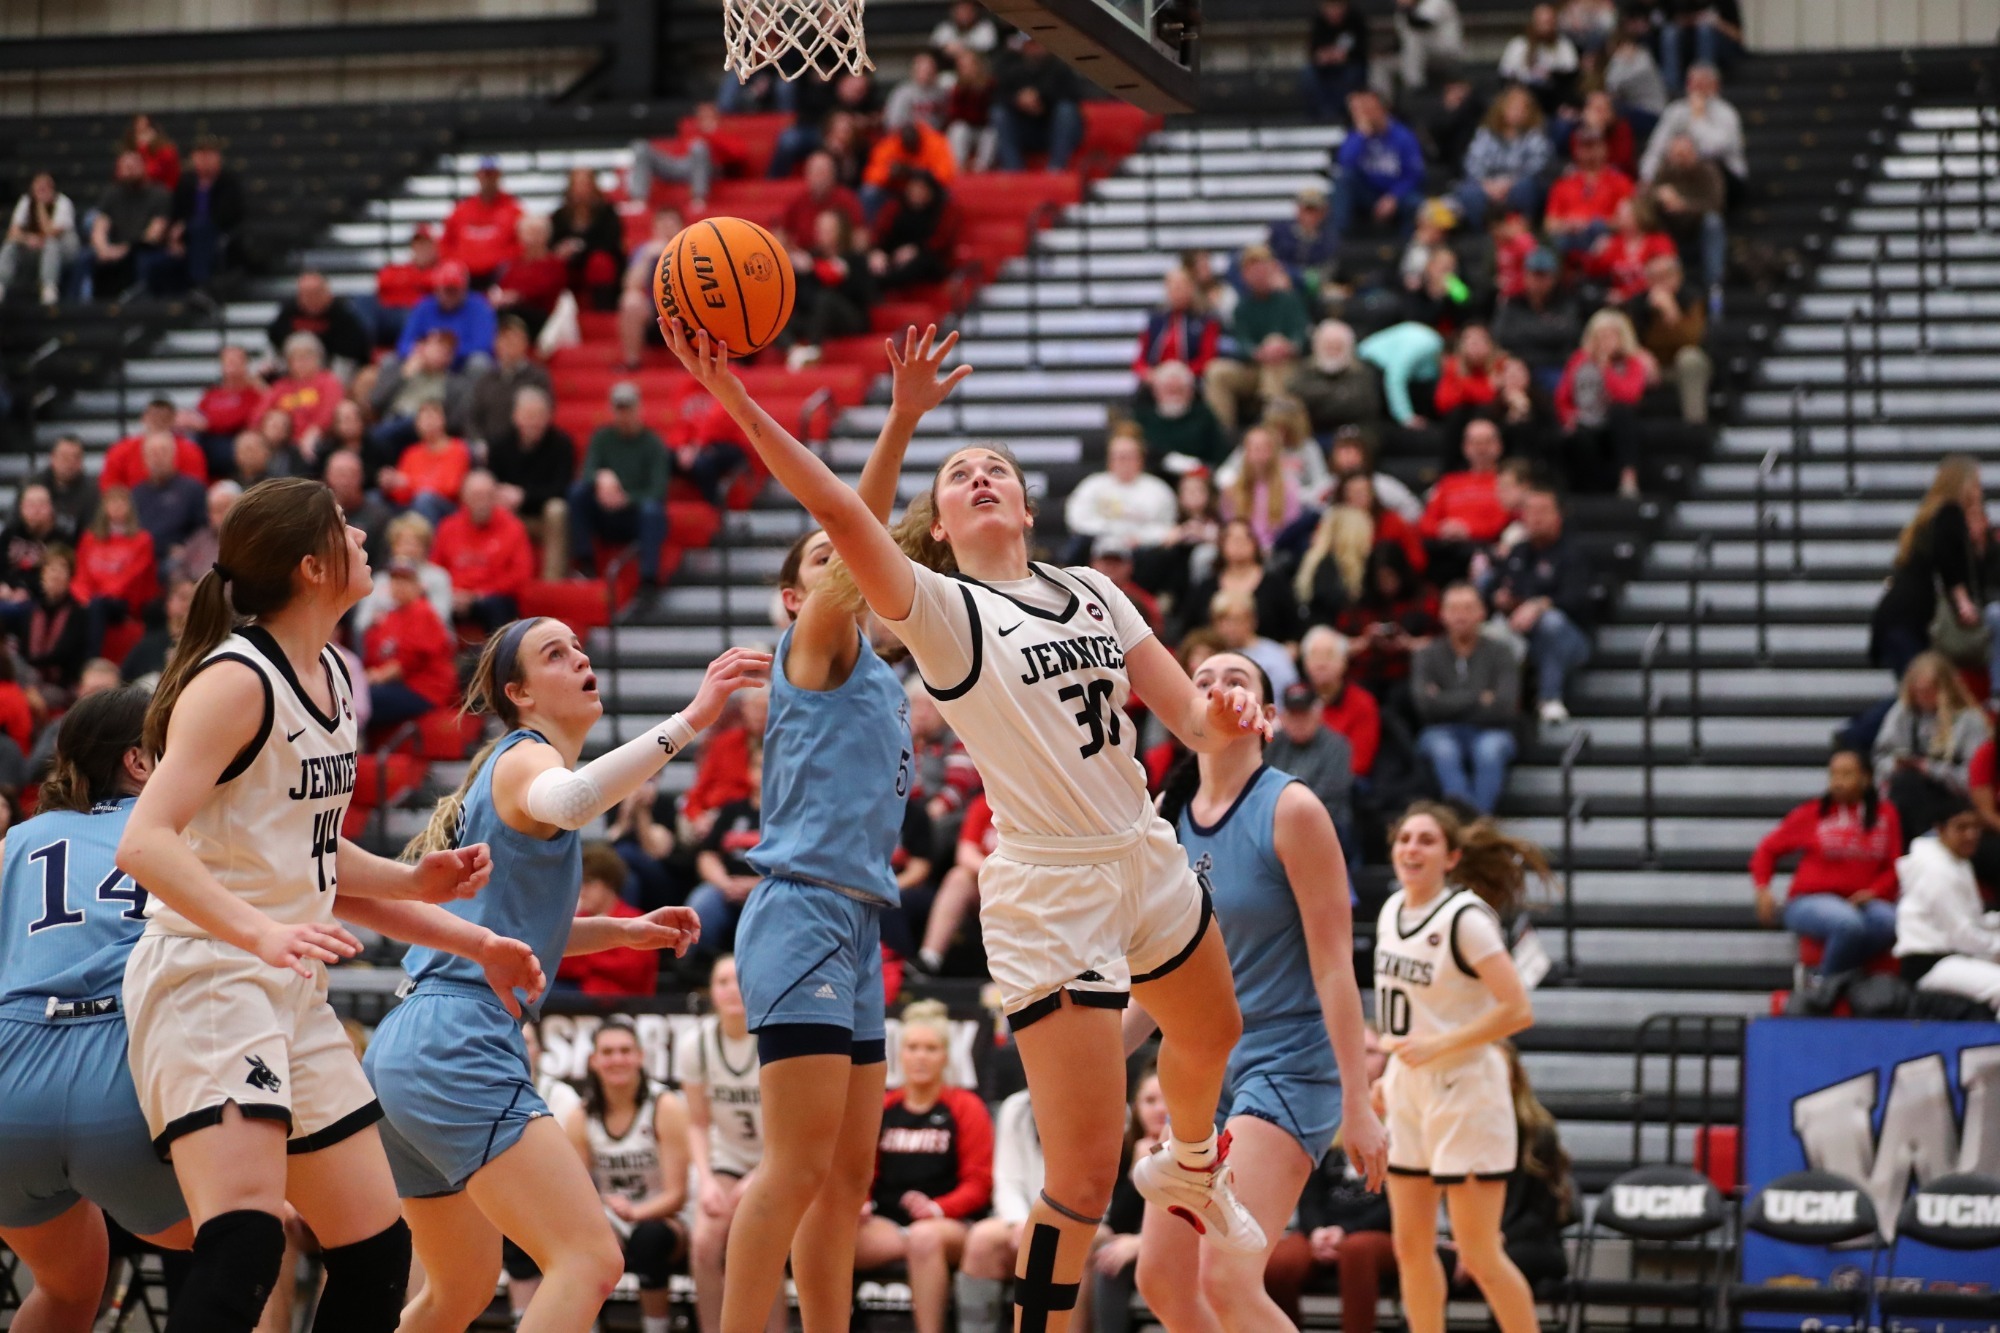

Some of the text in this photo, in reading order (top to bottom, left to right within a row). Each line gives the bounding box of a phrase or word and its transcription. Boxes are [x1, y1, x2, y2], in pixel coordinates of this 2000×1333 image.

[1020, 636, 1126, 685] JENNIES
[1058, 679, 1121, 759] 30
[896, 748, 911, 797] 5
[312, 807, 343, 892] 44
[28, 838, 152, 936] 14
[1380, 986, 1411, 1036] 10
[1612, 1184, 1708, 1219] UCM
[1763, 1189, 1858, 1224] UCM
[1916, 1193, 2000, 1227] UCM
